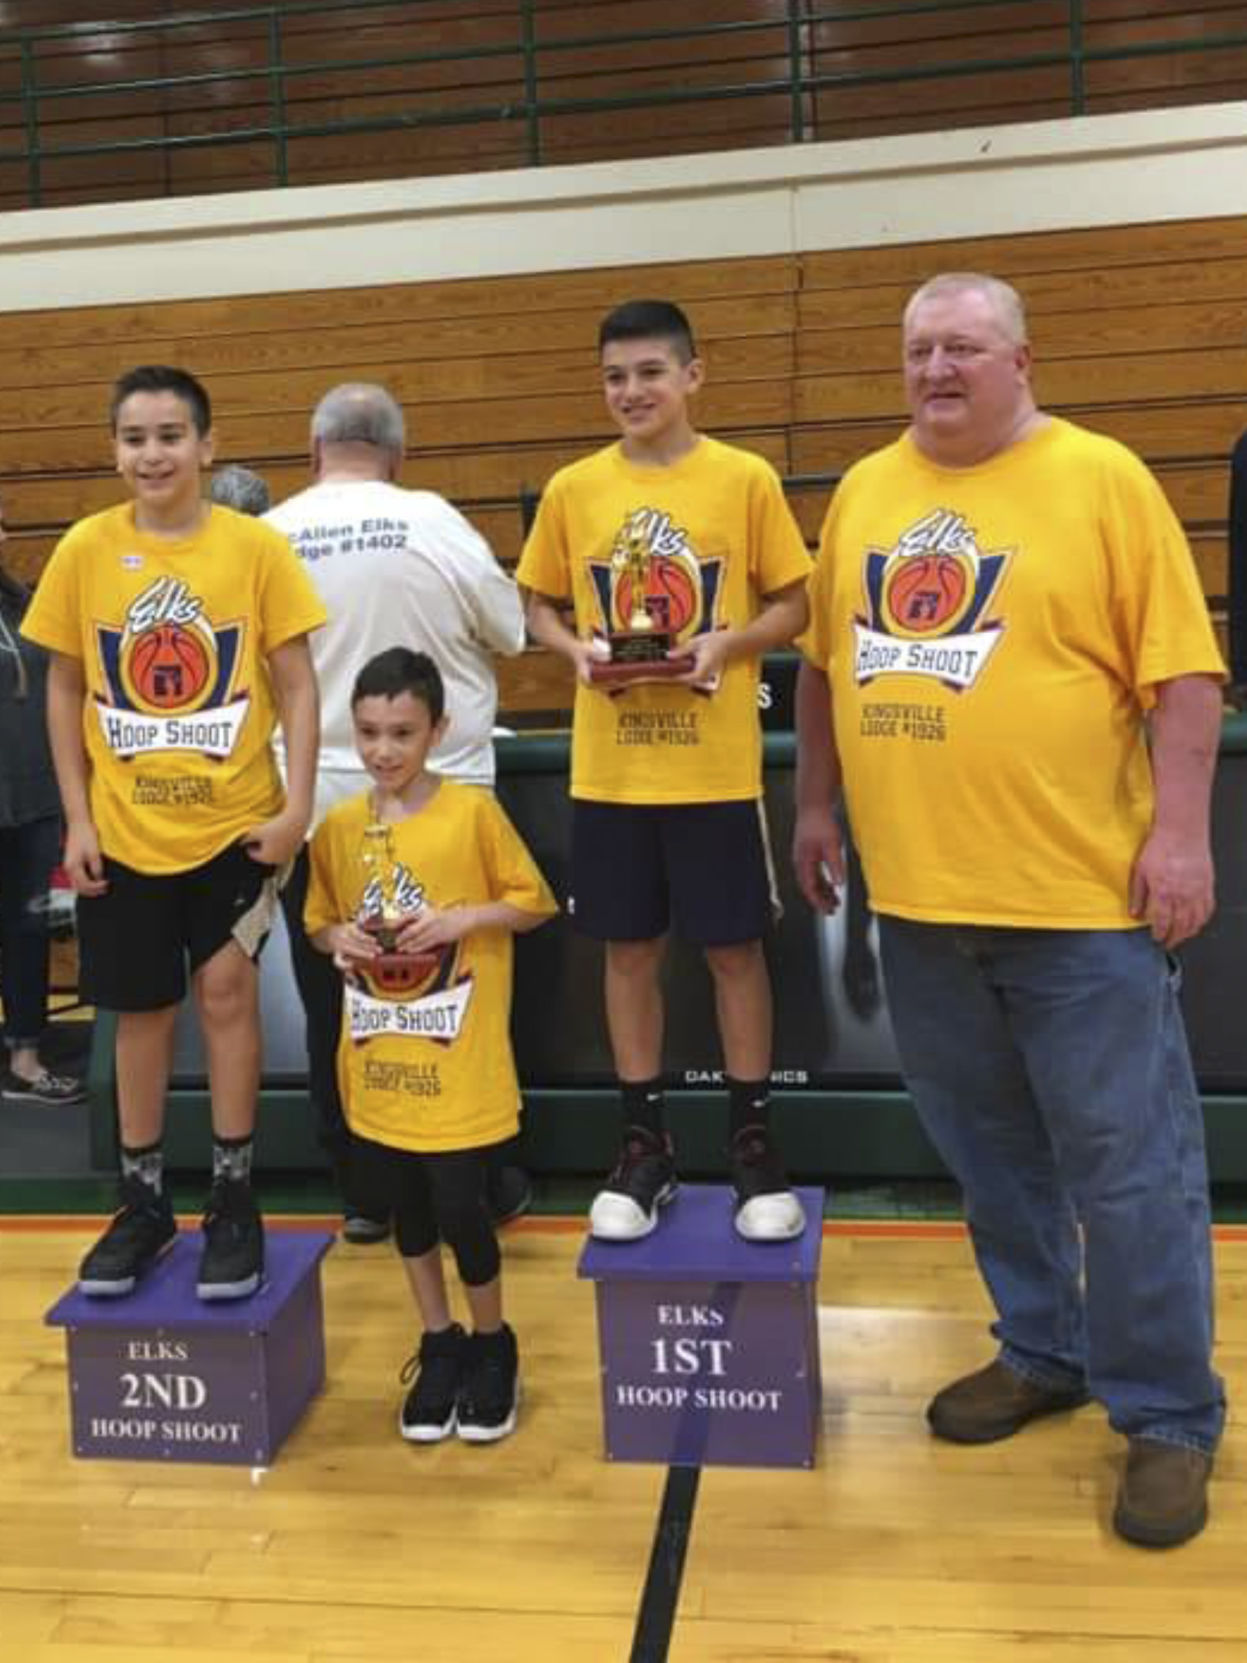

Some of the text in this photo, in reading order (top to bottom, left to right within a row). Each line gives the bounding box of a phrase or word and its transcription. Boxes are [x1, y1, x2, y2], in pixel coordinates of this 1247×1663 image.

[288, 518, 409, 543] cAllen Elks
[295, 534, 407, 560] dge #1402
[129, 575, 204, 632] Elks
[907, 644, 978, 678] SHOOT
[107, 716, 233, 748] HOOP SHOOT
[396, 1005, 458, 1032] SHOOT
[657, 1304, 724, 1326] ELKS
[128, 1341, 188, 1360] ELKS
[651, 1337, 732, 1376] 1ST
[120, 1373, 206, 1410] 2ND
[617, 1384, 782, 1411] HOOP SHOOT
[91, 1418, 242, 1444] HOOP SHOOT
